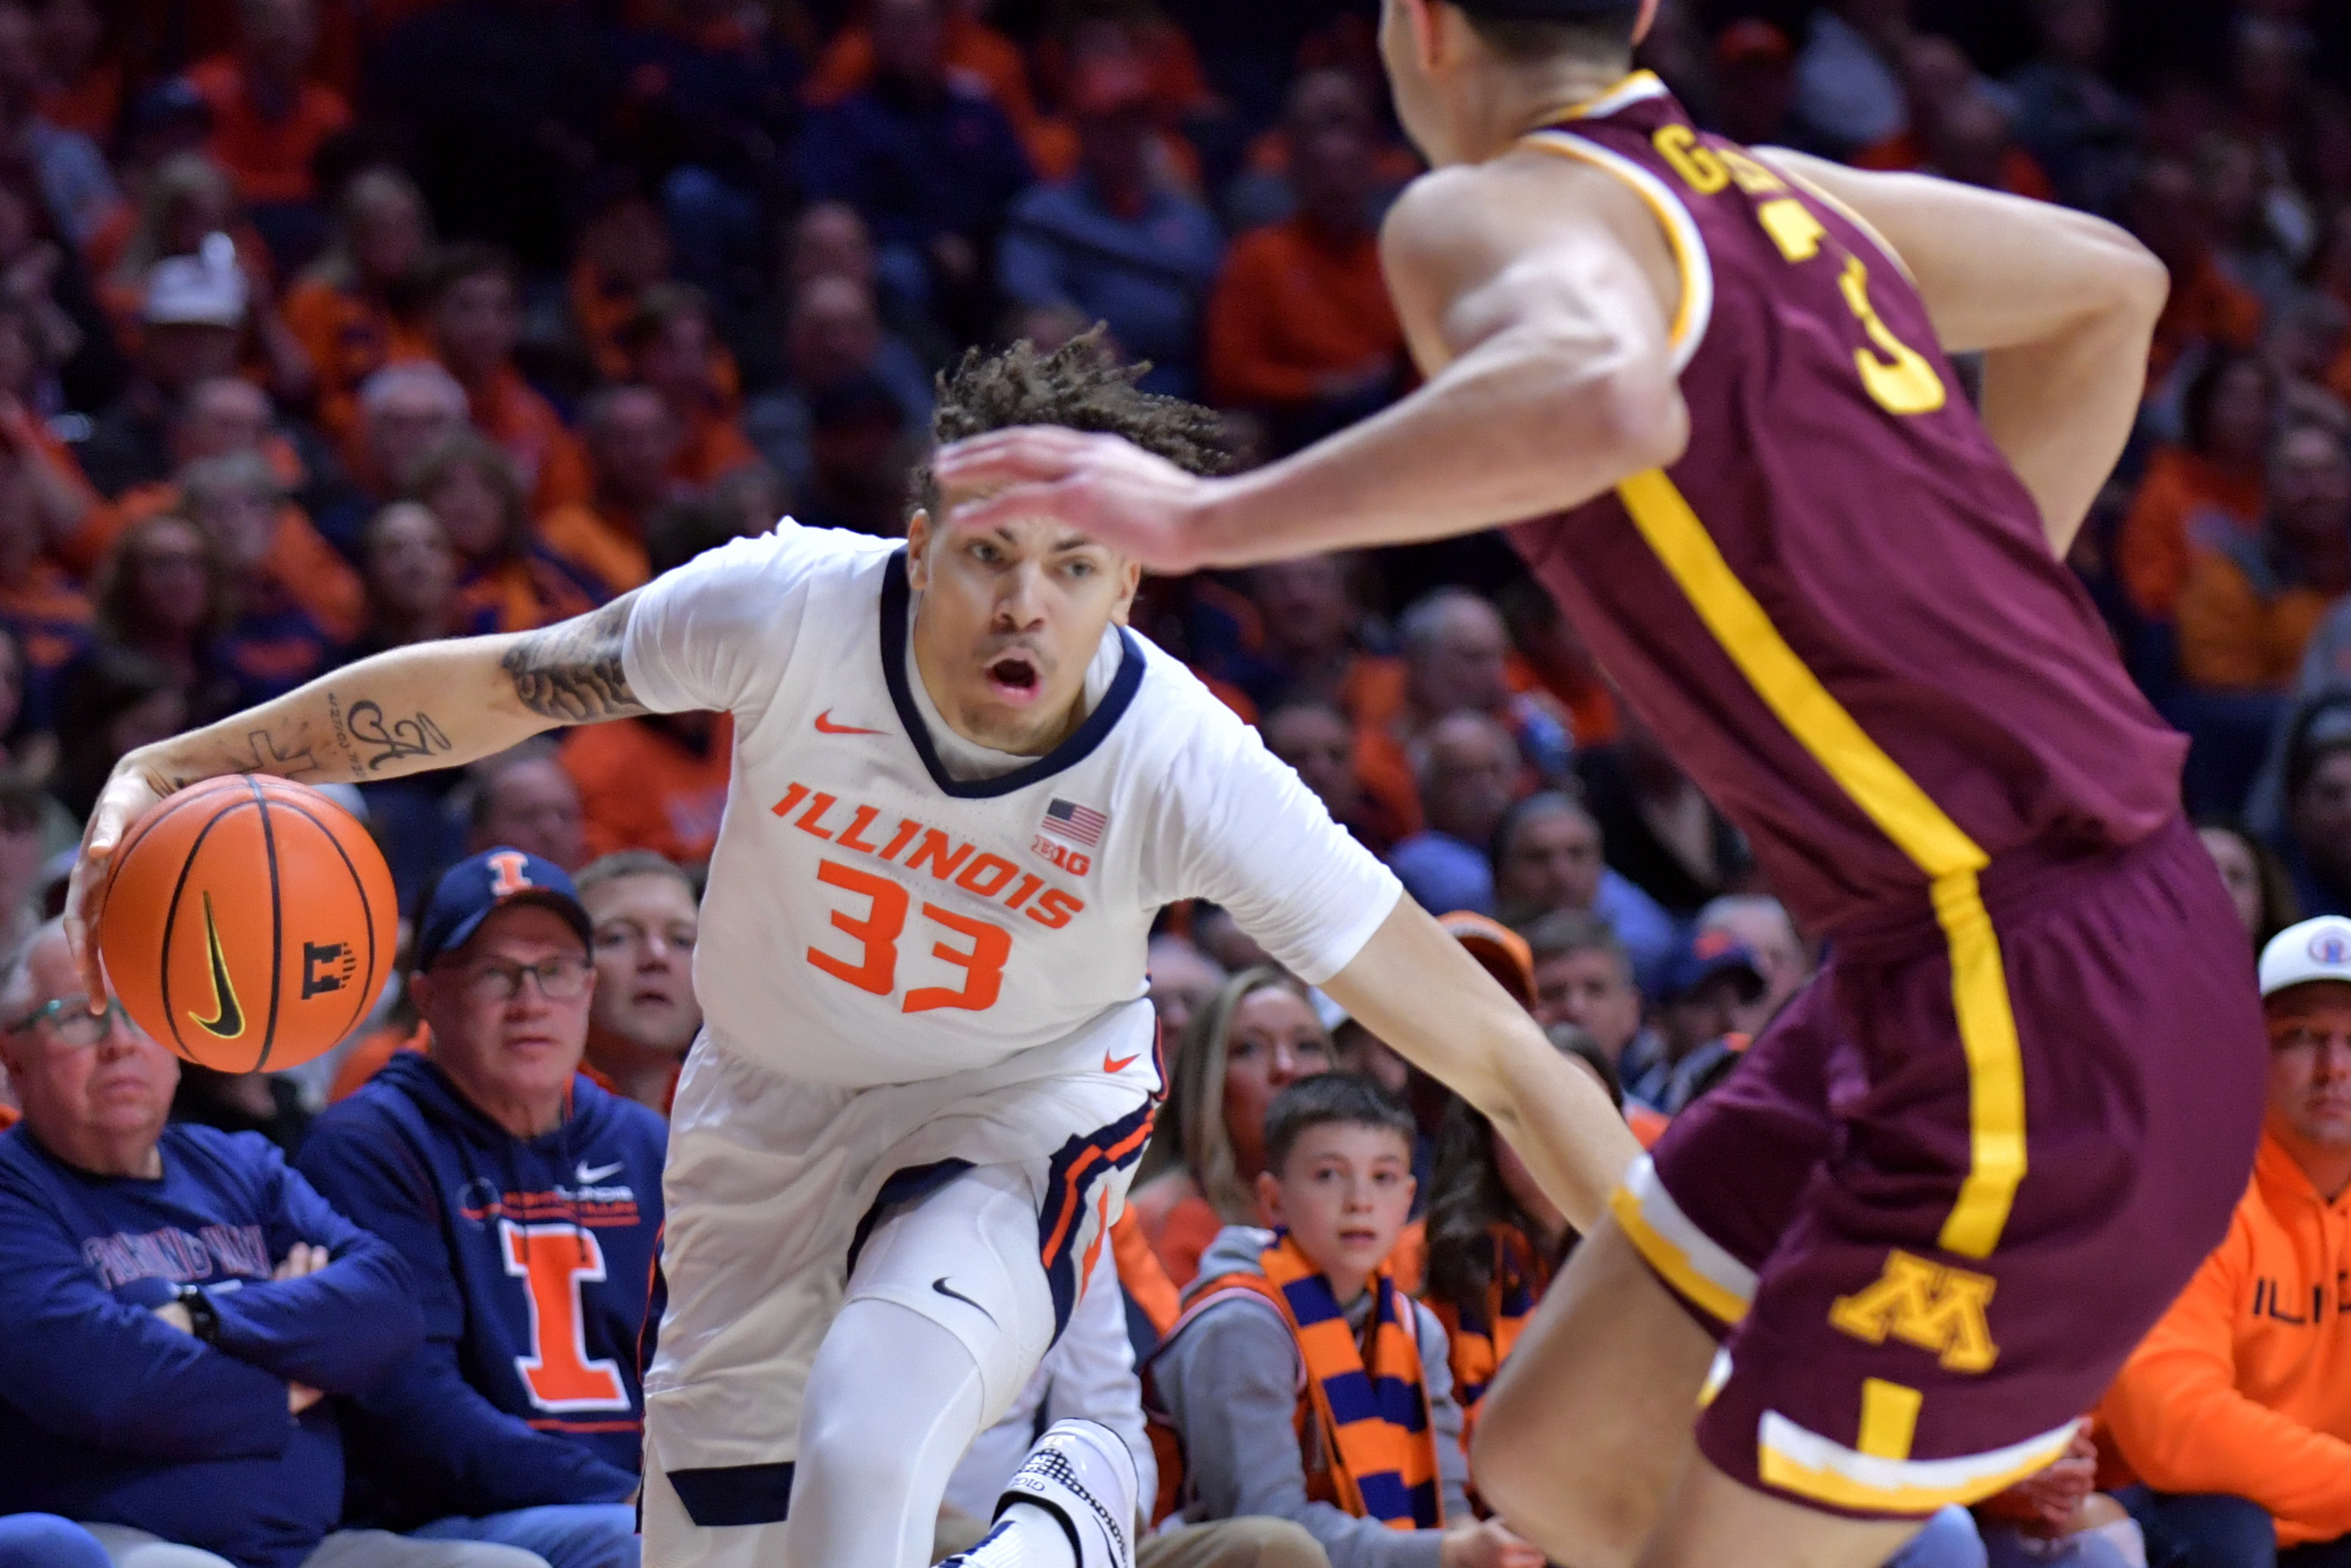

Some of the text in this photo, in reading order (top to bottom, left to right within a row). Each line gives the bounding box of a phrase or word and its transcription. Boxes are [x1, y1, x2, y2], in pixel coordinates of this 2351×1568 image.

[771, 781, 1085, 930] ILLINOIS
[806, 858, 1013, 1014] 33
[497, 1217, 632, 1412] I
[1827, 1248, 2001, 1375] M
